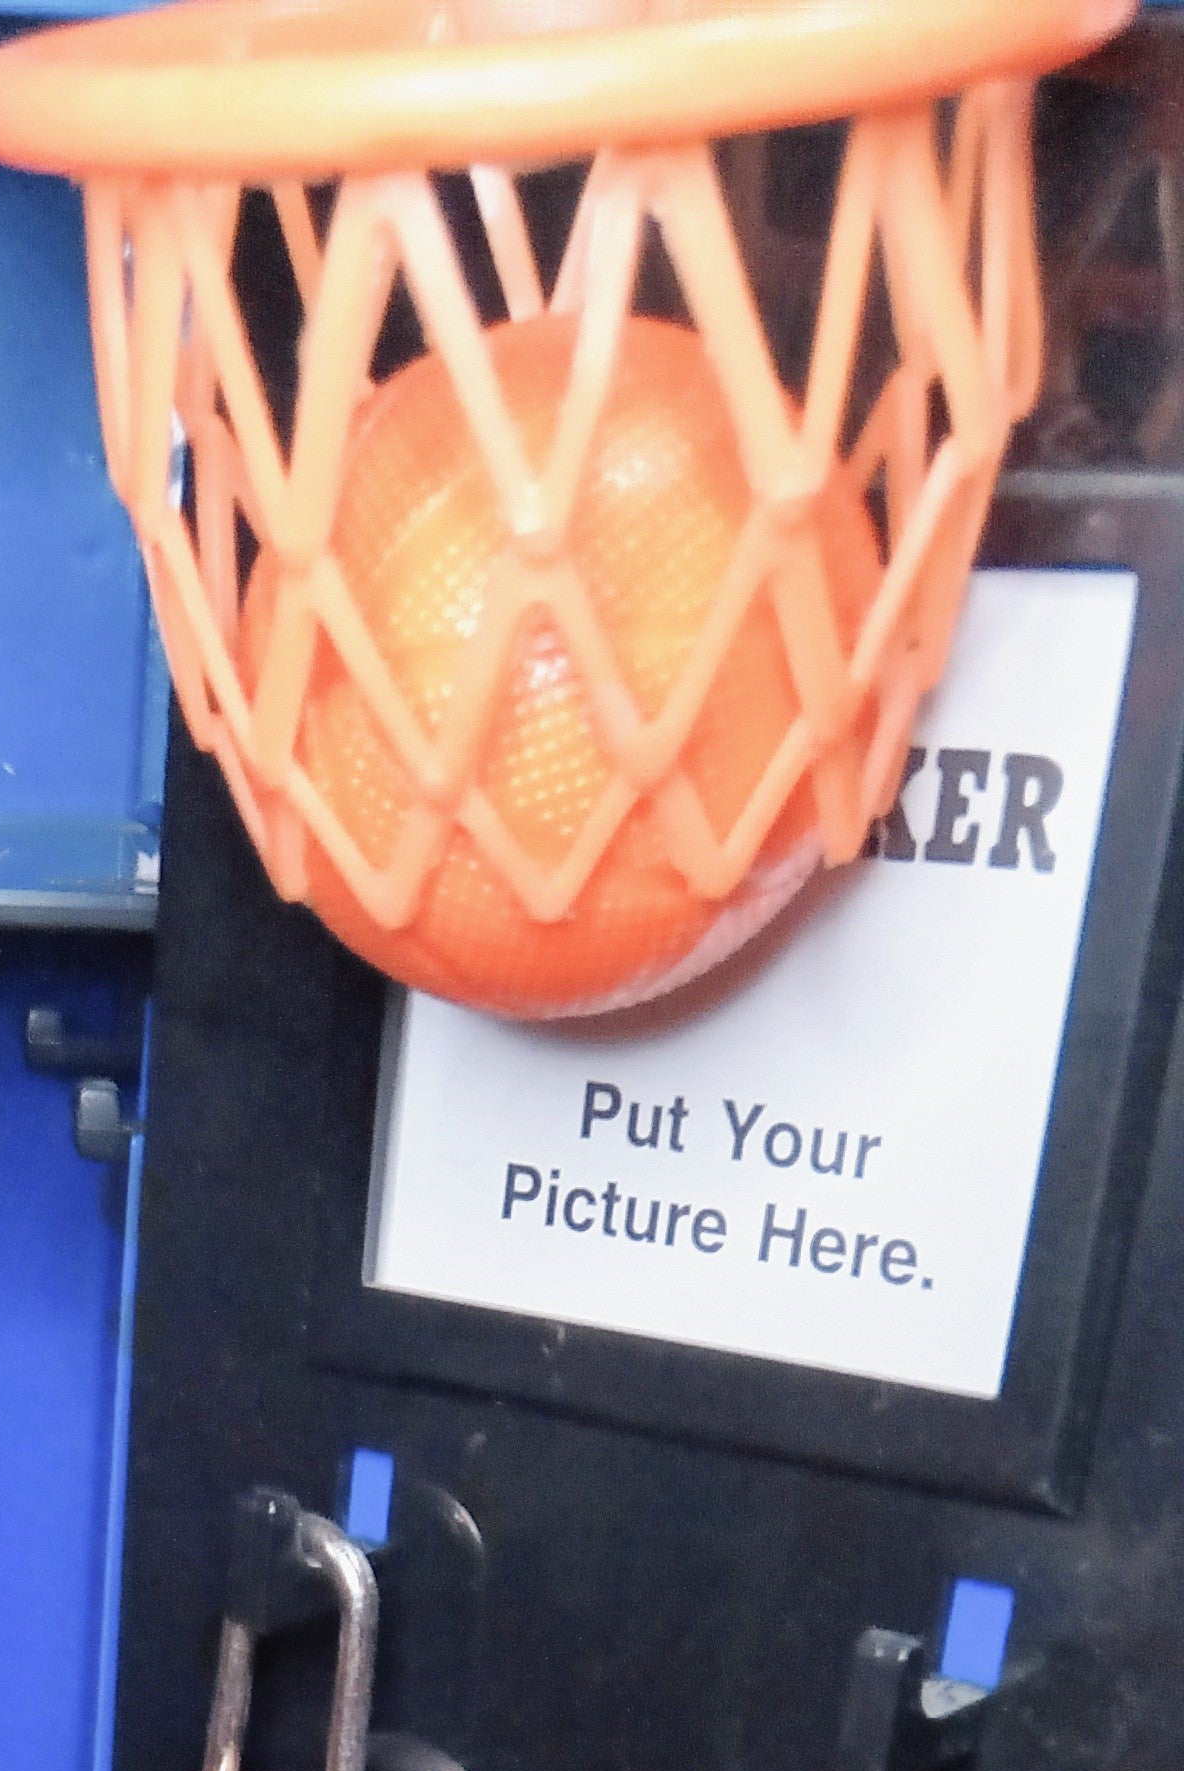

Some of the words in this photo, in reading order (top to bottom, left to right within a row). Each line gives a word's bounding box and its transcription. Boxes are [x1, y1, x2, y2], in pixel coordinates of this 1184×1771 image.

[580, 1081, 687, 1152] Put
[722, 1099, 882, 1179] Your
[501, 1162, 728, 1254] Picture
[758, 1203, 935, 1290] Here.
